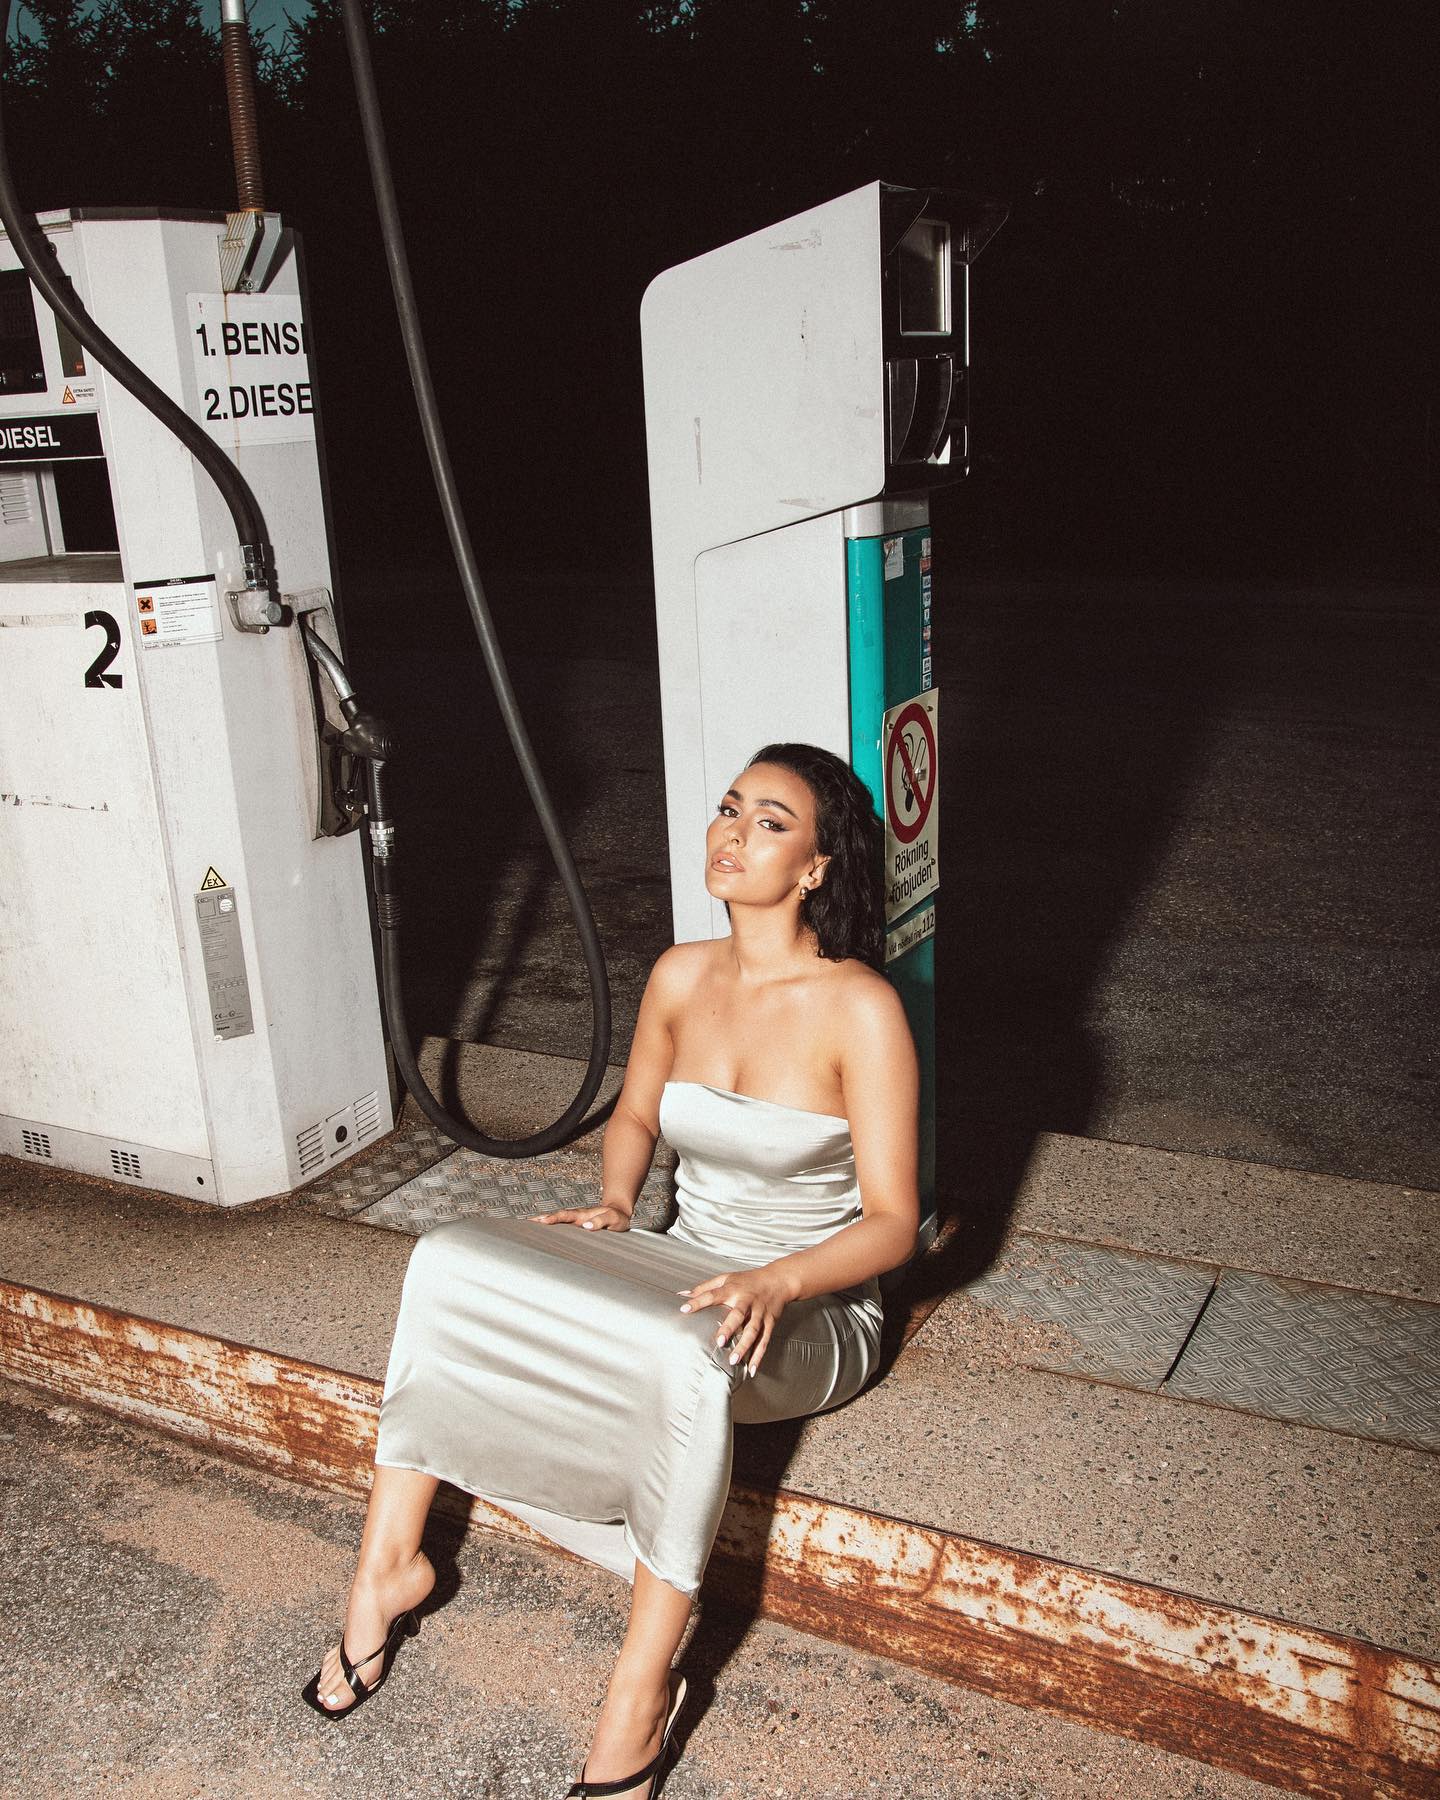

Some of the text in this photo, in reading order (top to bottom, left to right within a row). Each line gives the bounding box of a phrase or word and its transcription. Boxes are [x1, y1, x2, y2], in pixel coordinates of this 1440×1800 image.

[196, 323, 216, 356] 1.
[84, 610, 122, 688] 2
[895, 840, 929, 876] Rökning
[207, 878, 219, 887] EX
[892, 863, 932, 905] förbjuden
[889, 942, 897, 955] Vid
[922, 912, 934, 933] 112
